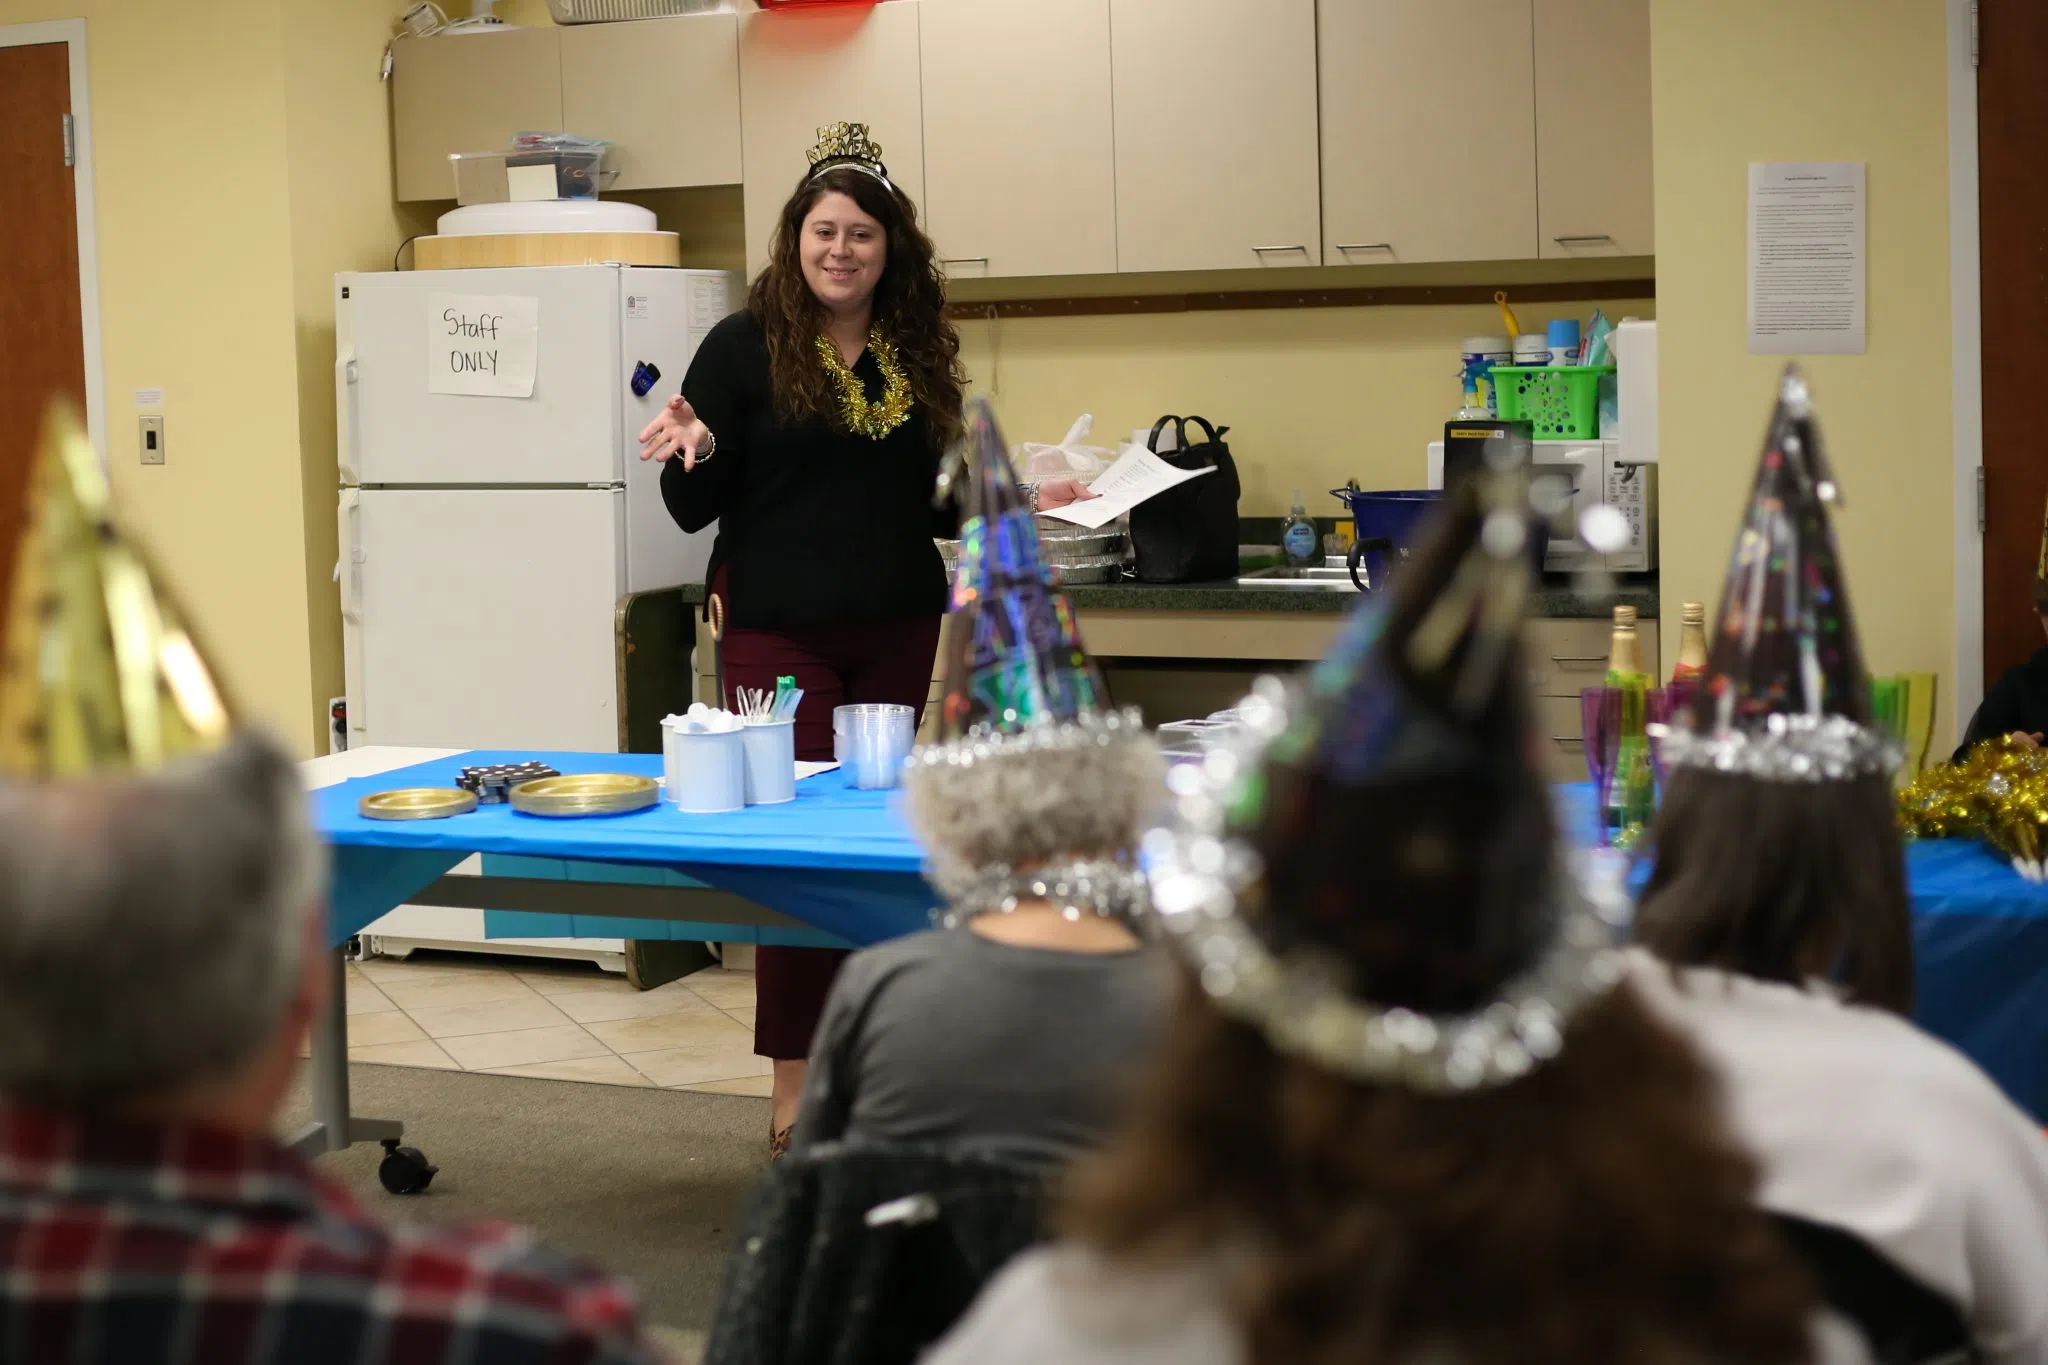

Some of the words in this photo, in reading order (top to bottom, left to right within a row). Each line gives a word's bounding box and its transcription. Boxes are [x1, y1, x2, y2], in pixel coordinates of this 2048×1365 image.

[816, 121, 869, 144] HAPPY
[805, 139, 843, 166] NEW
[841, 139, 883, 162] YEAR
[443, 308, 503, 341] Staff
[450, 349, 498, 376] ONLY
